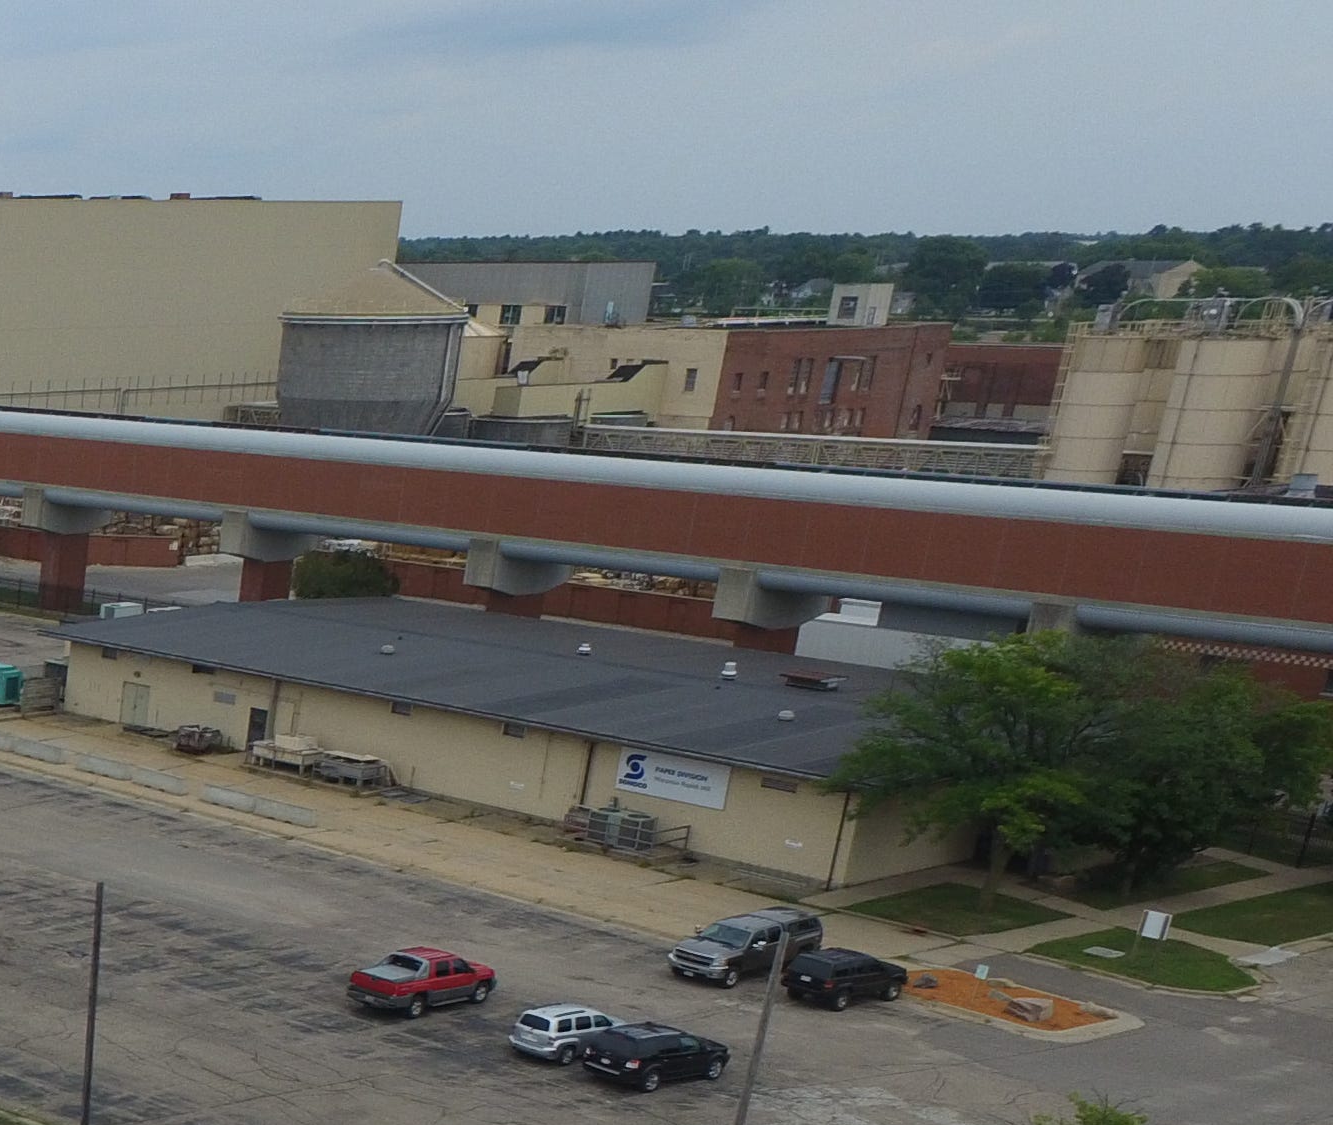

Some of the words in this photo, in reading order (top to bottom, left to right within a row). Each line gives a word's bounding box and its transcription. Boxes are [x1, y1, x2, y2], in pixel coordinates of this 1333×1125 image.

[655, 766, 676, 776] PAPER
[677, 770, 708, 782] DIVISION
[619, 778, 648, 789] SONOCO
